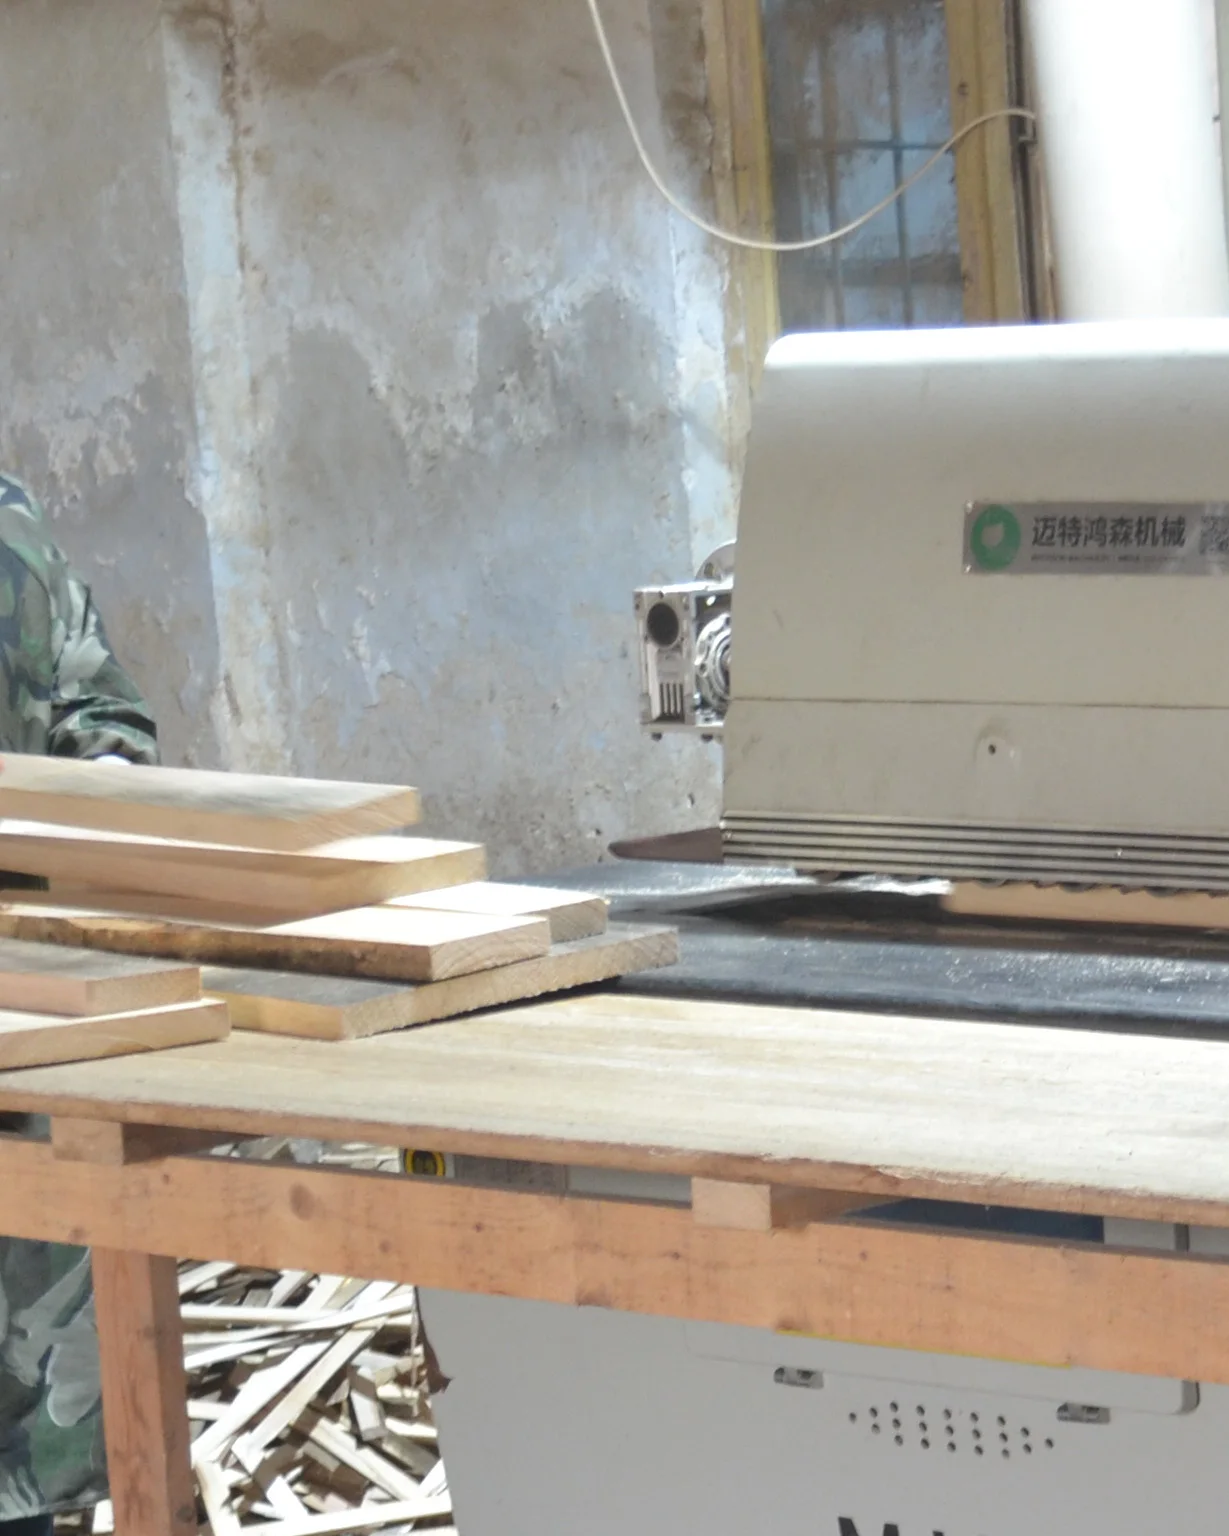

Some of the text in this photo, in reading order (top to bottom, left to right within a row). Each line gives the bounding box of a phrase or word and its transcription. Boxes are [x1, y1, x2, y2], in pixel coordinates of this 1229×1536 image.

[1031, 515, 1186, 547] 迈特鸿森机械
